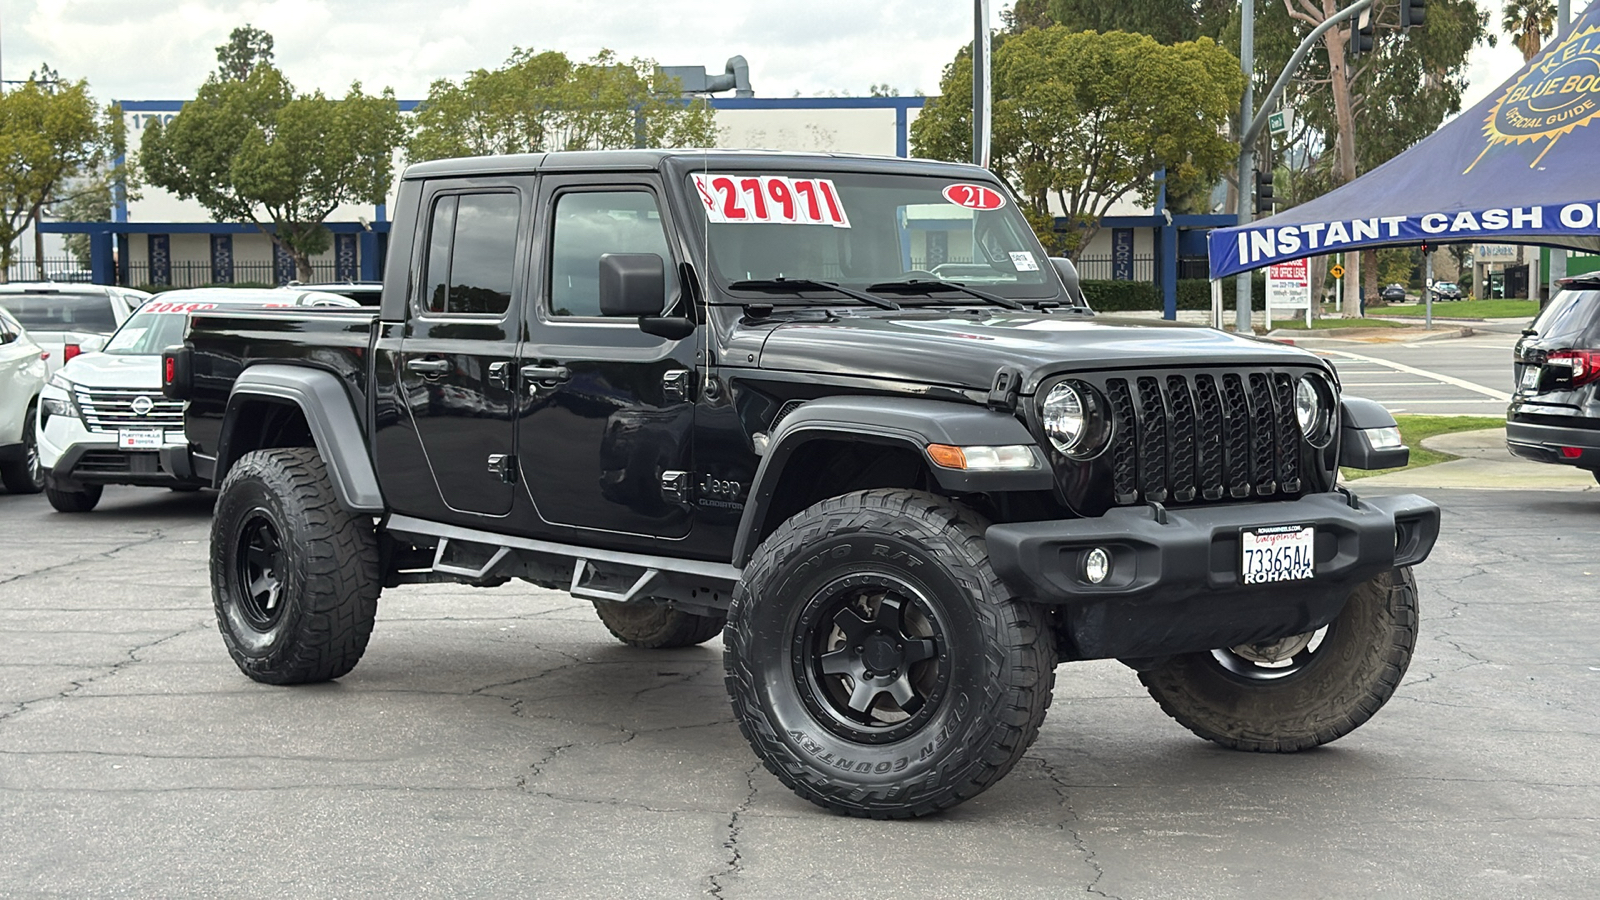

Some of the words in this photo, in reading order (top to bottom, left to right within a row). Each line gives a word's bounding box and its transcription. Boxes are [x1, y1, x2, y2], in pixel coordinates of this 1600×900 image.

[1506, 76, 1565, 105] BLUE
[1505, 106, 1543, 129] OFFICIAL
[1545, 98, 1596, 126] GUIDE
[696, 176, 846, 224] $27971
[961, 186, 988, 208] 21
[1237, 215, 1407, 265] INSTANT
[1420, 206, 1543, 234] CASH
[1560, 203, 1600, 229] O
[216, 237, 230, 284] FLOORIN
[1279, 266, 1293, 279] OFFICE
[700, 473, 741, 500] Jeep
[699, 498, 743, 510] GLADIATOR
[1245, 544, 1311, 574] 73365A4
[1244, 568, 1314, 585] ROHANA
[787, 729, 911, 775] COUNTRY
